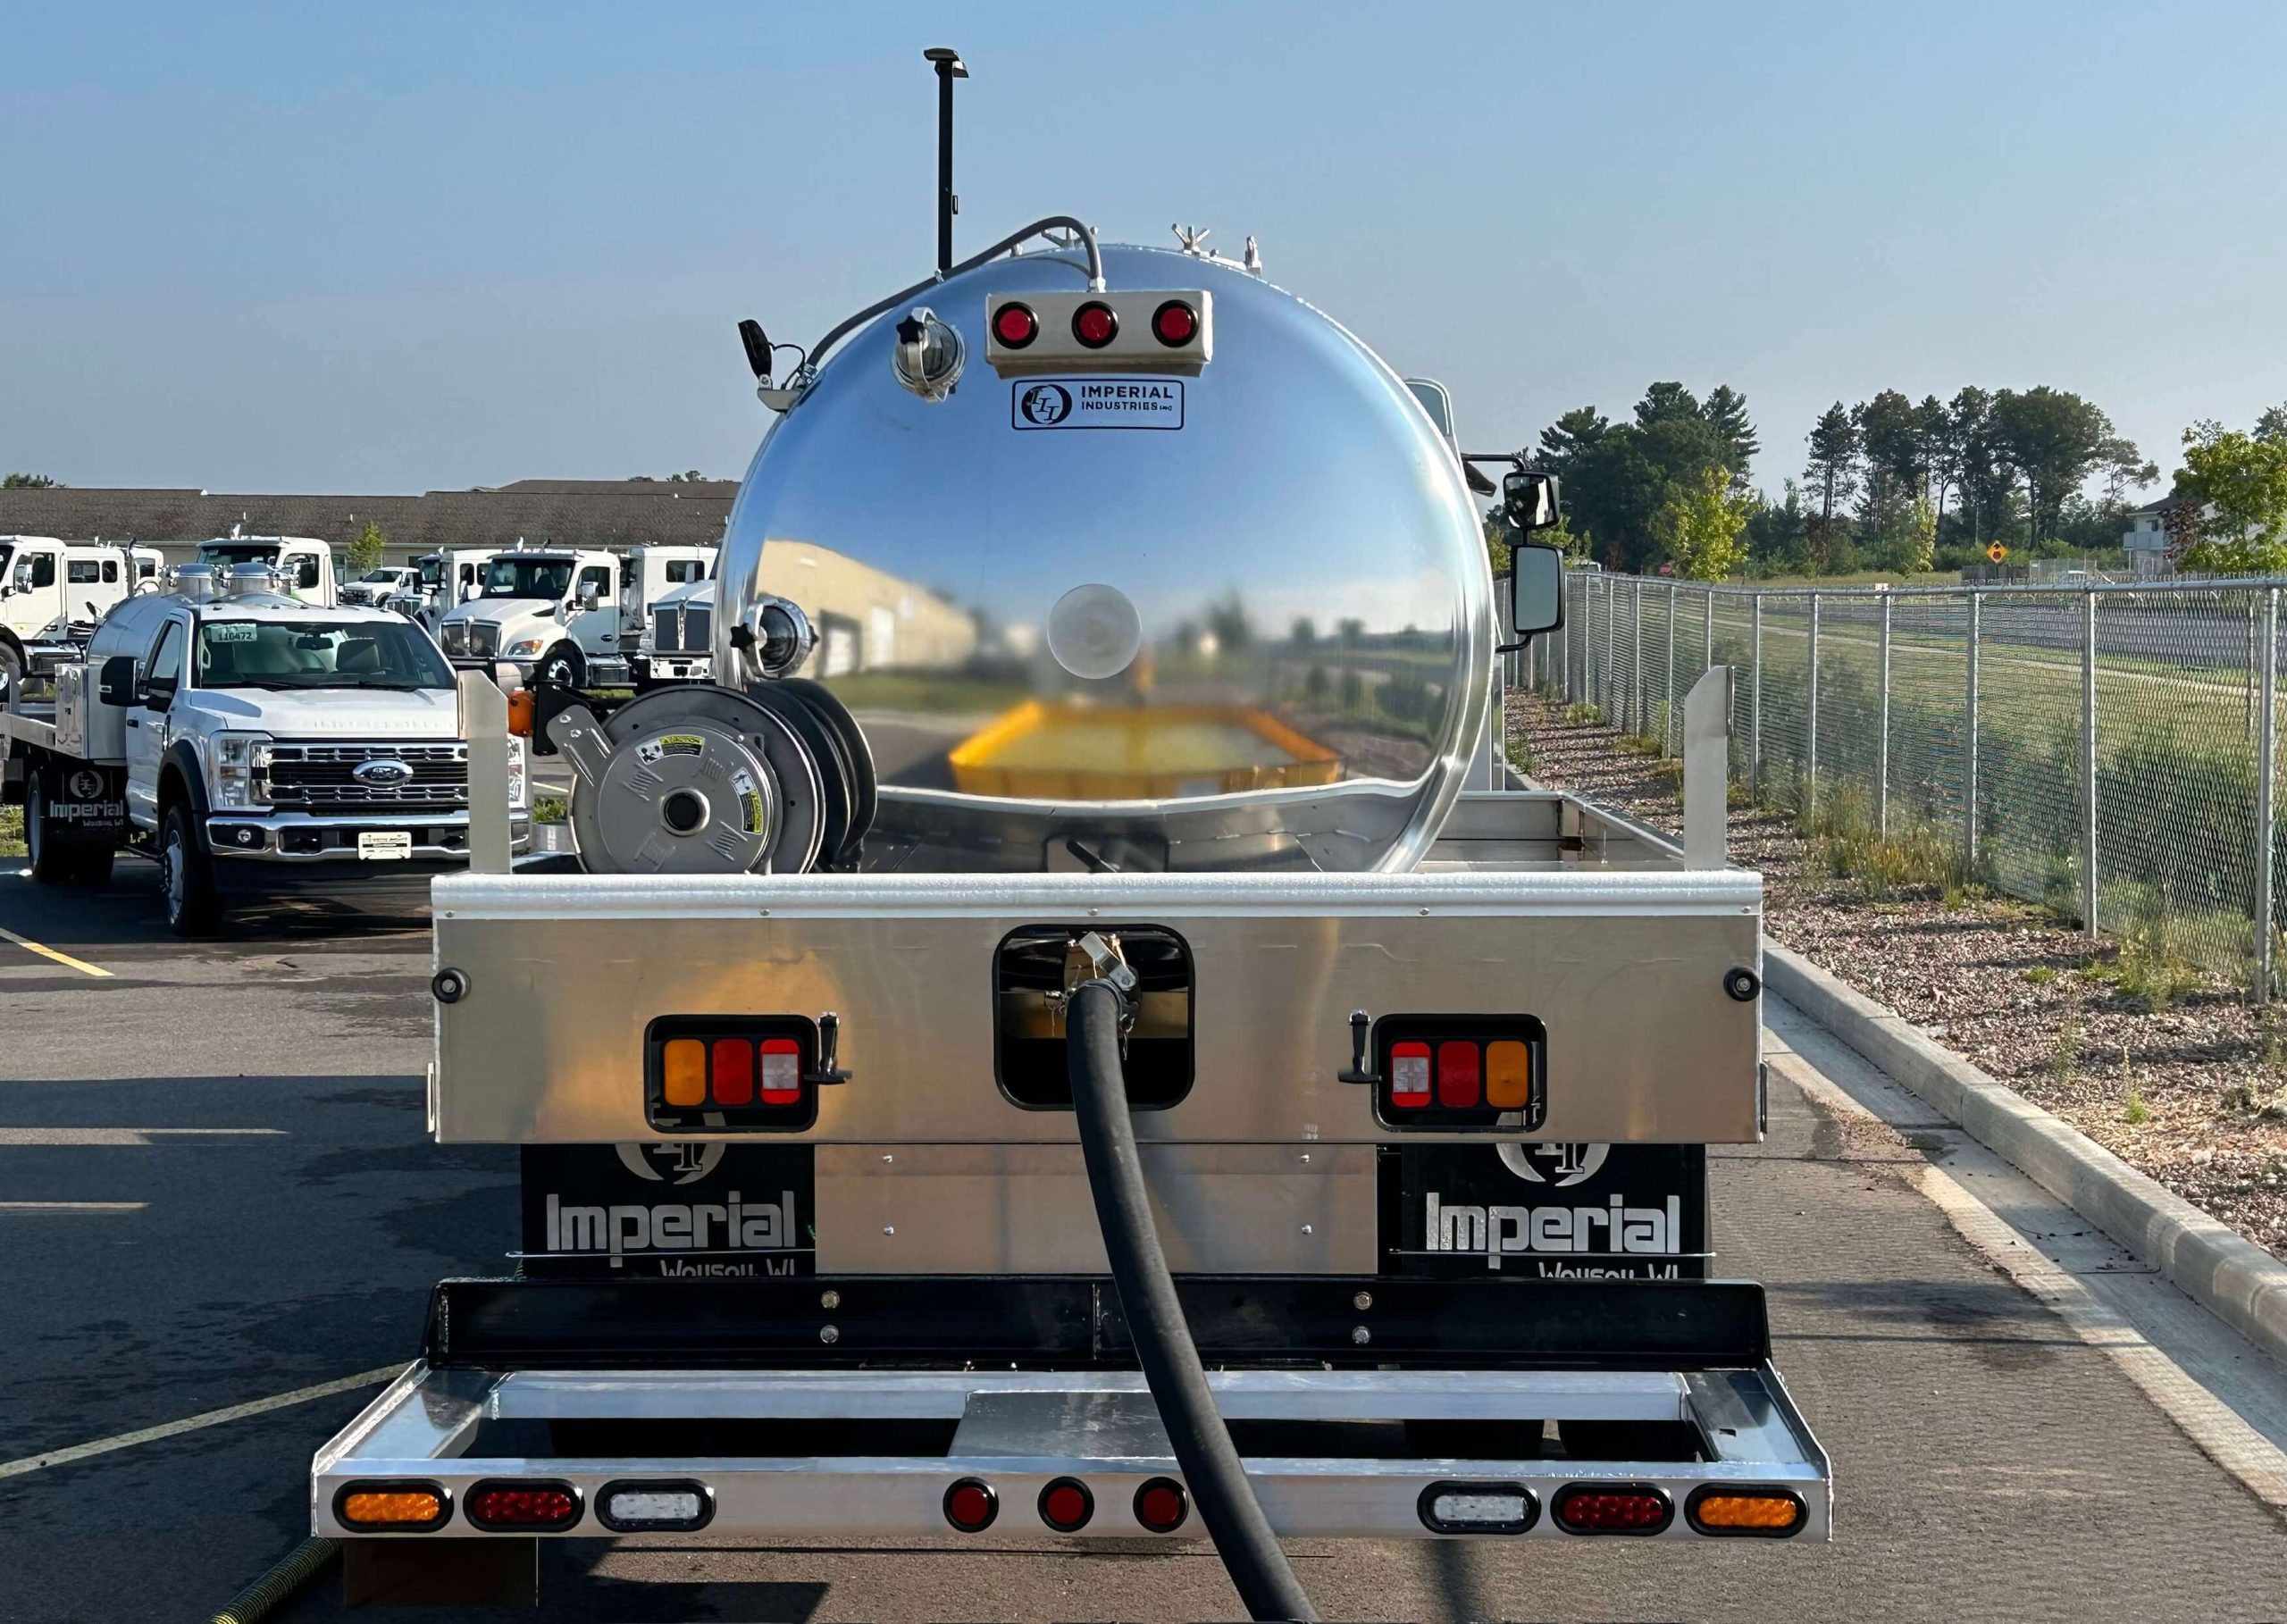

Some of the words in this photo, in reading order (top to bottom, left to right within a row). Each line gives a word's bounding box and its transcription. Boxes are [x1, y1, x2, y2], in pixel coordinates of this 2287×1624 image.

[1081, 385, 1173, 398] IMPERIAL
[1081, 400, 1158, 411] INDUSTRIES
[49, 799, 124, 823] Imperial
[546, 1191, 796, 1268] Imperial
[1426, 1192, 1680, 1269] Imperial
